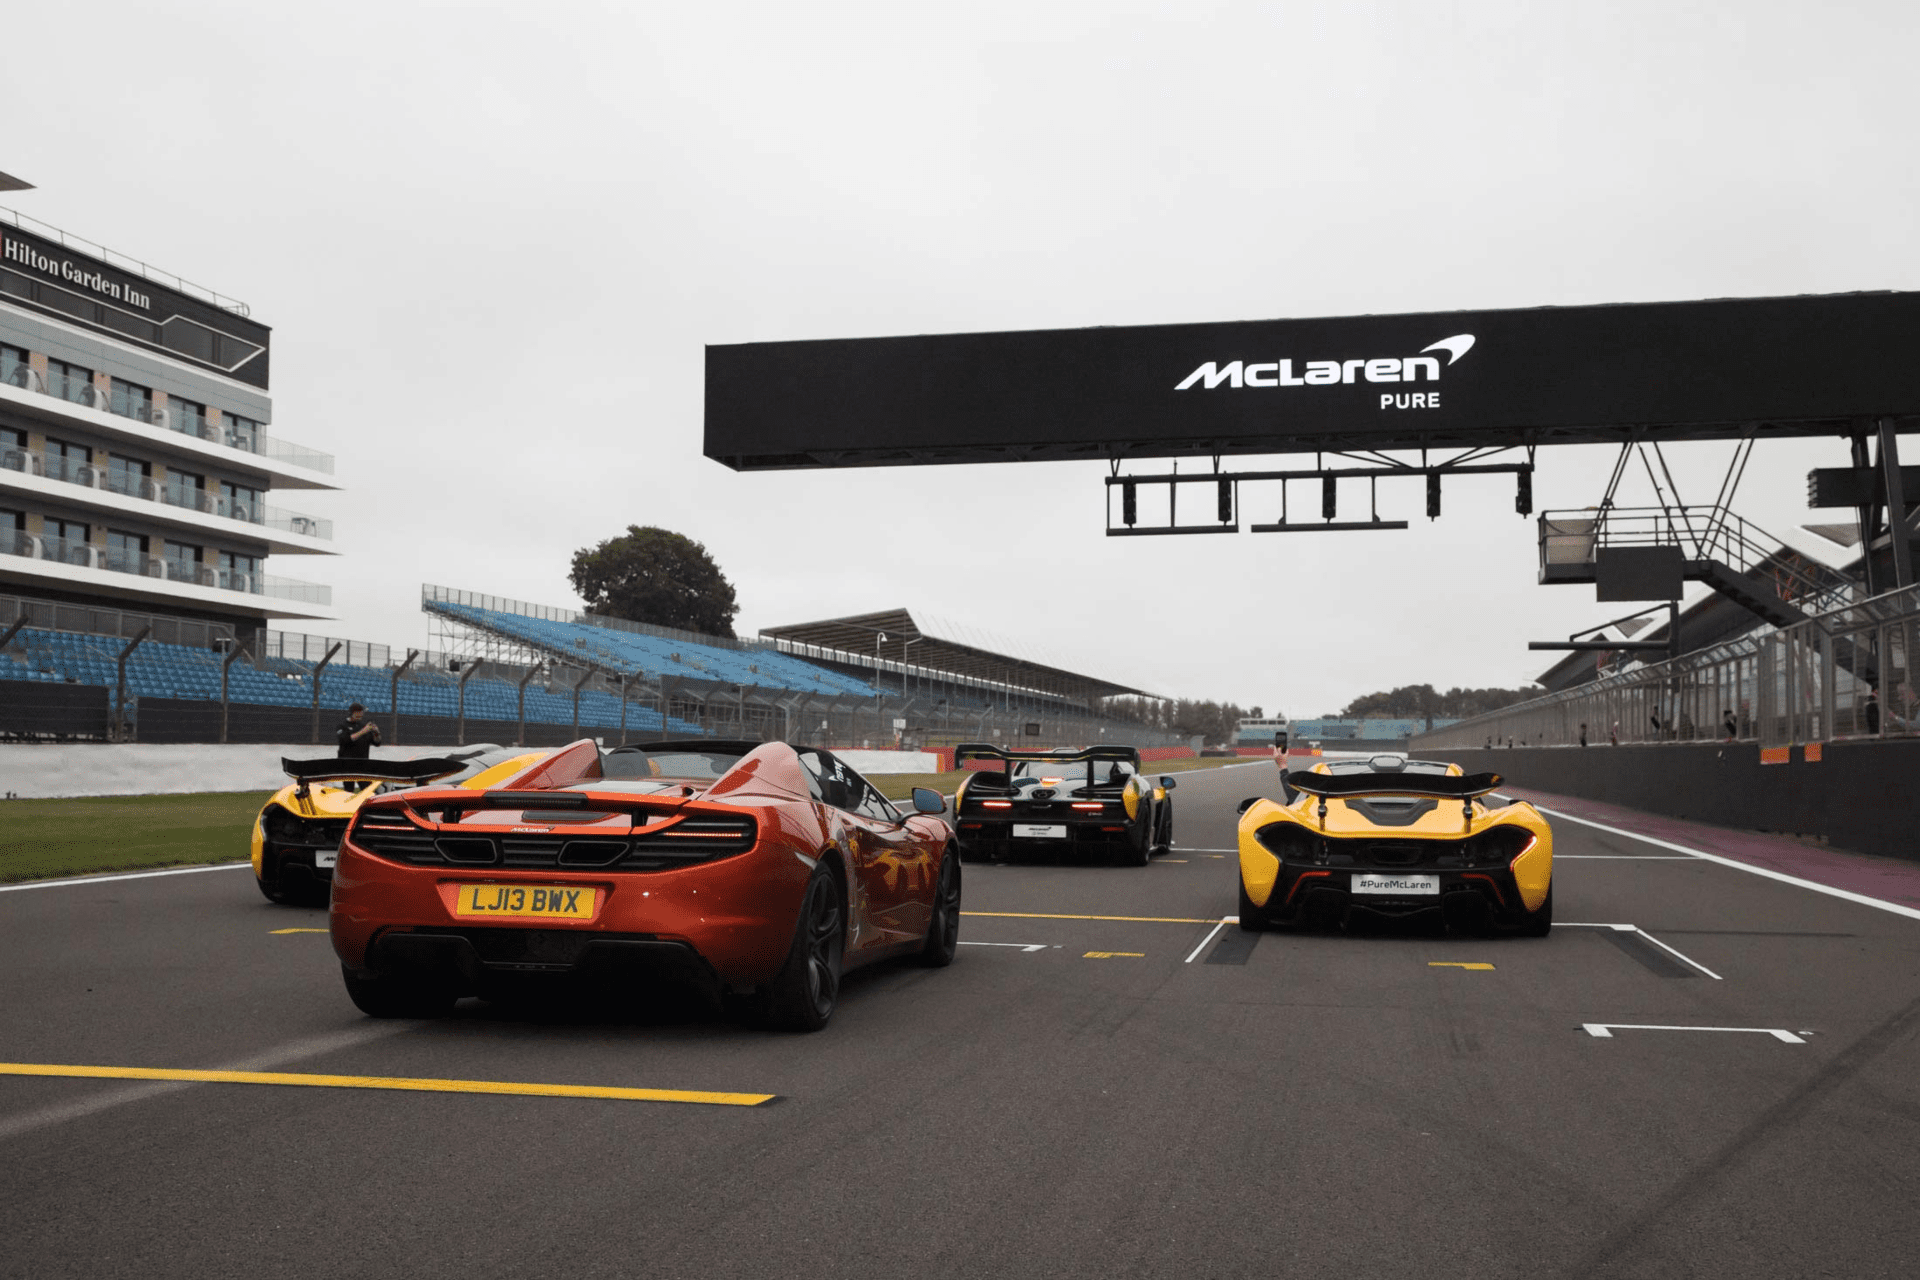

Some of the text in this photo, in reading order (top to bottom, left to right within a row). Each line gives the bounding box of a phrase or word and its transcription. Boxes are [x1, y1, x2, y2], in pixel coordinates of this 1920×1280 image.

[5, 238, 150, 310] Hilton Garden Inn
[1174, 357, 1440, 390] McLaren
[1380, 392, 1441, 410] PURE
[1360, 880, 1432, 889] #PureMcLaren
[472, 888, 580, 913] LJ13 BWX
